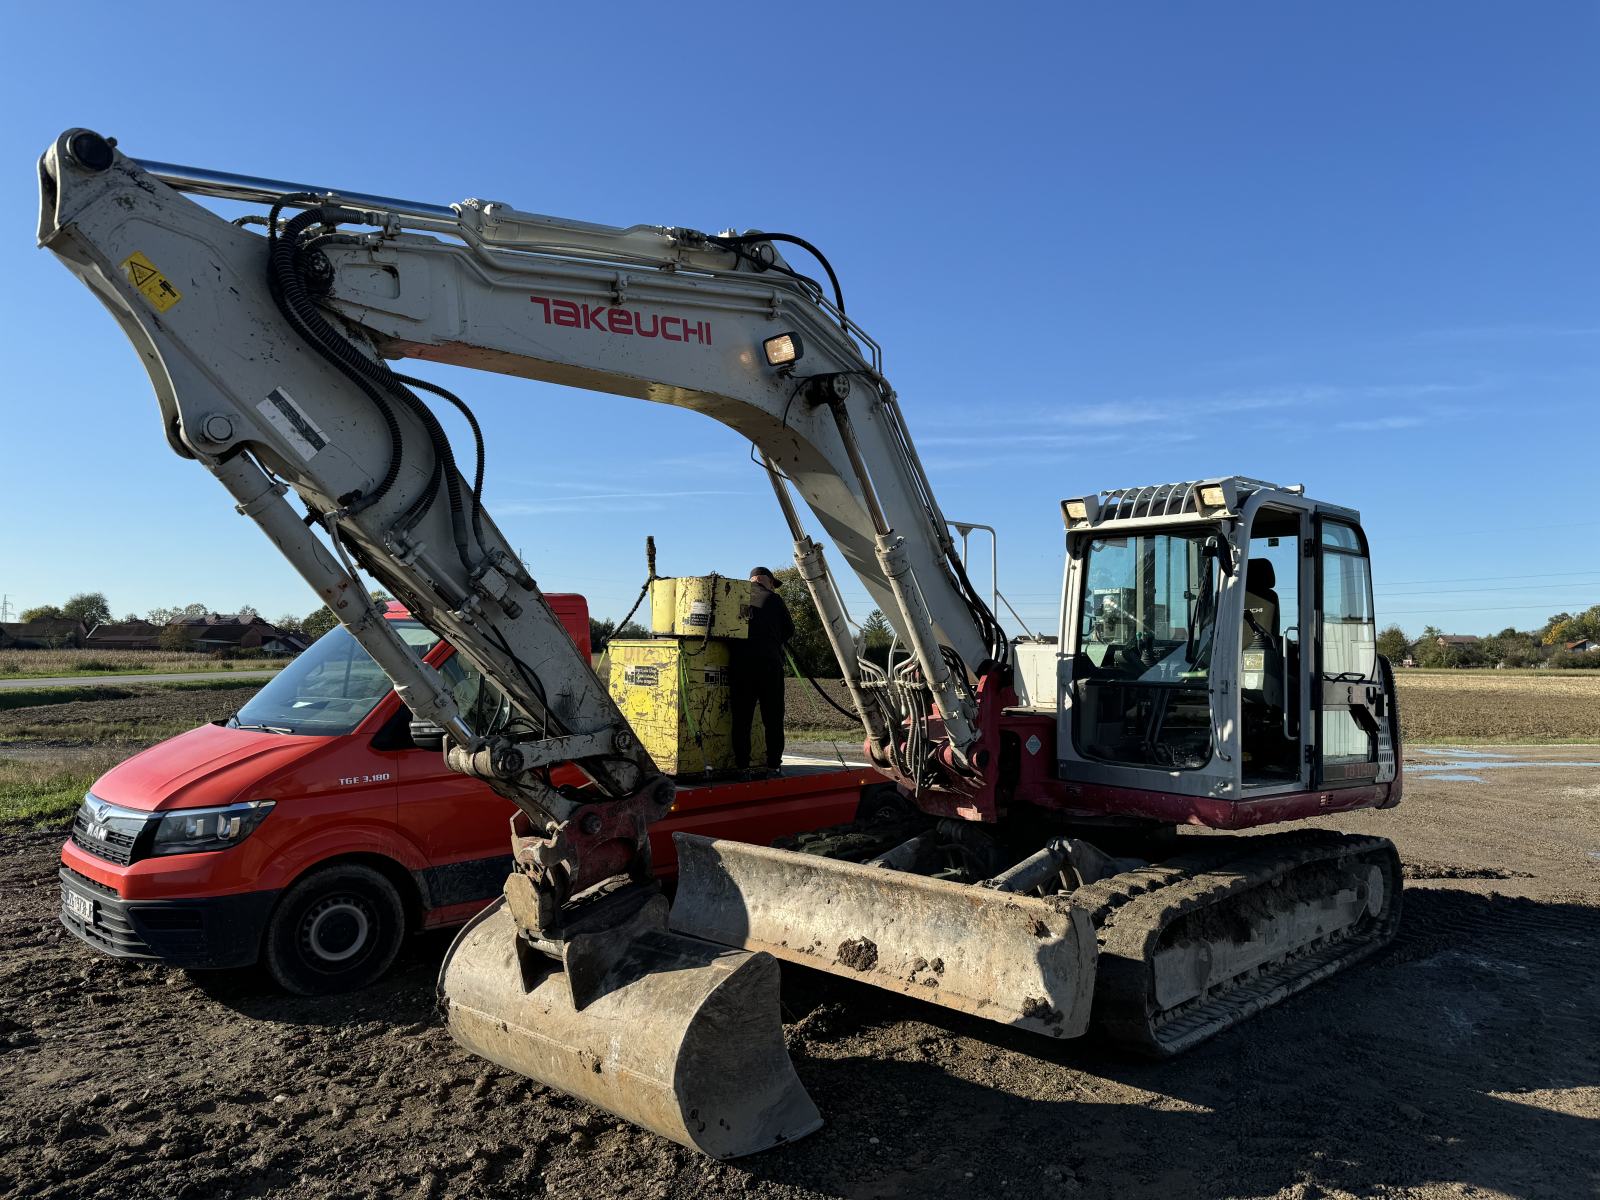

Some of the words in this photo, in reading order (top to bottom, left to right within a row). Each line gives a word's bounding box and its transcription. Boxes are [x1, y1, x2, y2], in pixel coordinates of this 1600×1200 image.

[339, 776, 360, 786] TGE
[362, 773, 390, 783] 3.180
[87, 822, 109, 841] MAN
